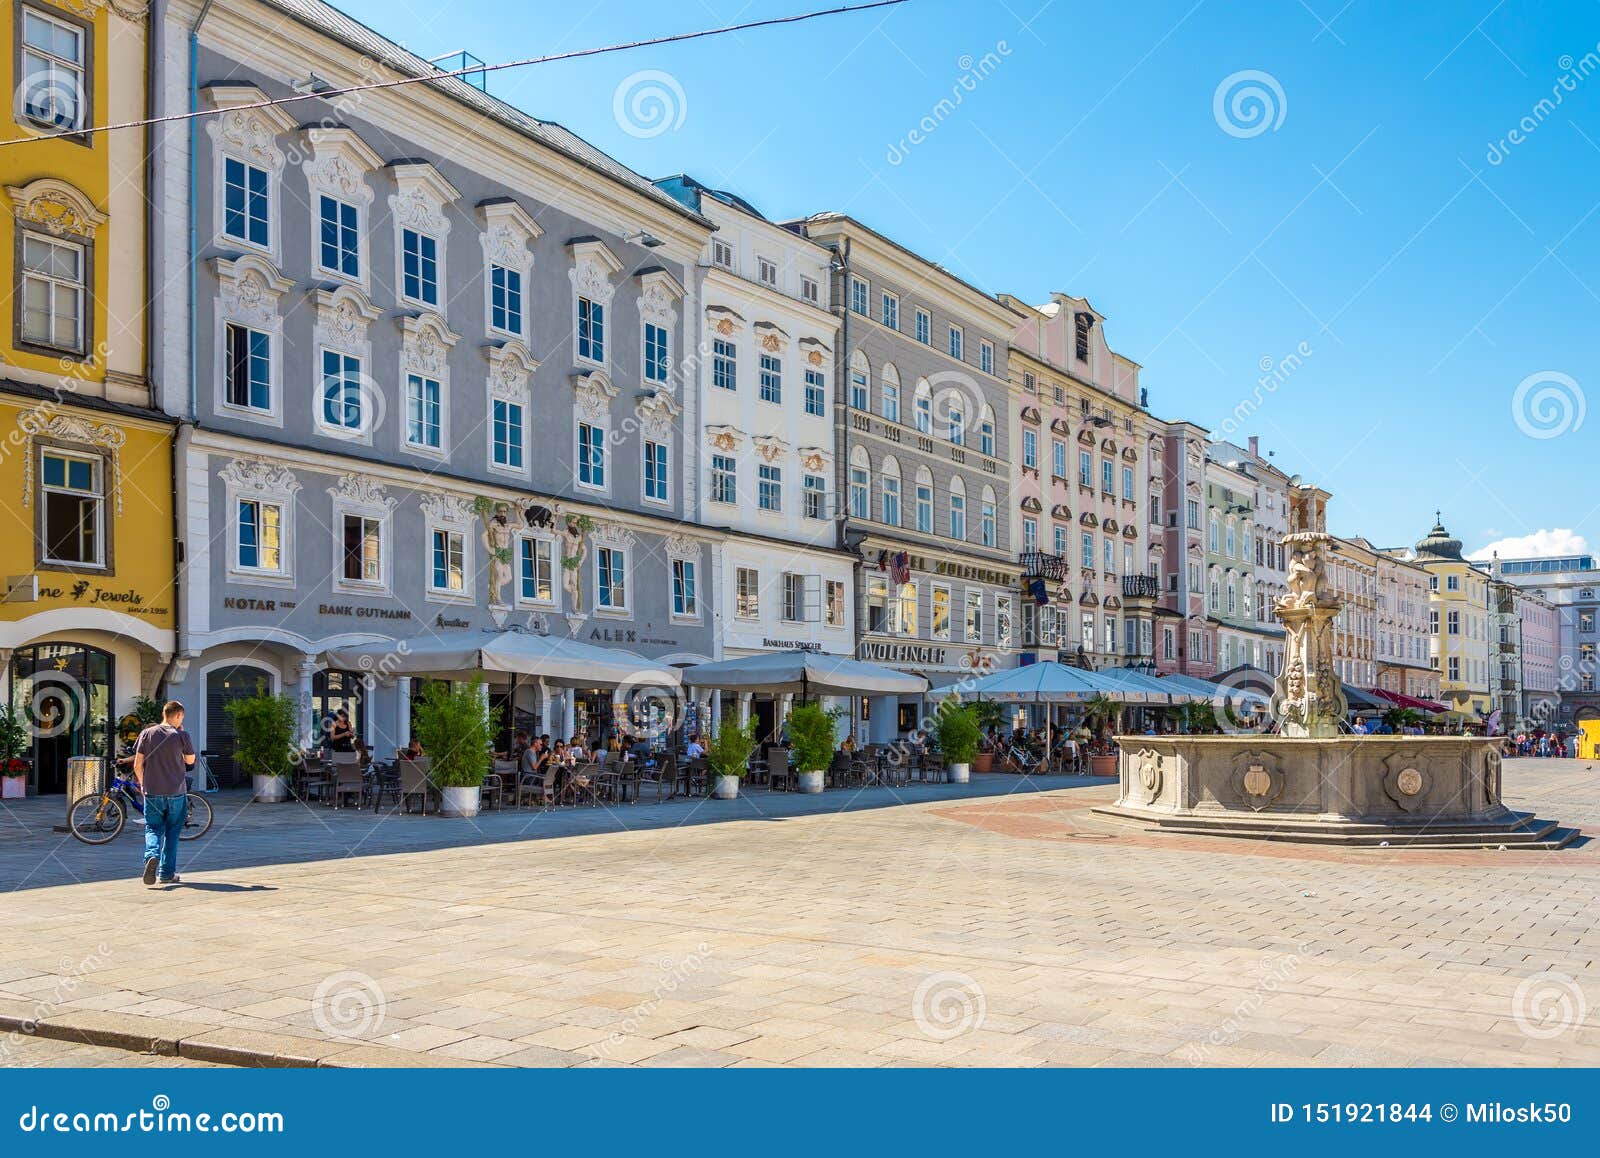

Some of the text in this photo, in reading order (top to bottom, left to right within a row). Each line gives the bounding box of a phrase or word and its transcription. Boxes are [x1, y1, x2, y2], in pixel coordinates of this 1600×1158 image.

[90, 588, 144, 604] Jewels
[224, 597, 276, 611] NOTAR
[319, 604, 411, 620] BANK GUTMANN
[590, 627, 637, 643] ALEX
[763, 638, 794, 649] BANKHAUS
[863, 642, 946, 664] WOLFINGER
